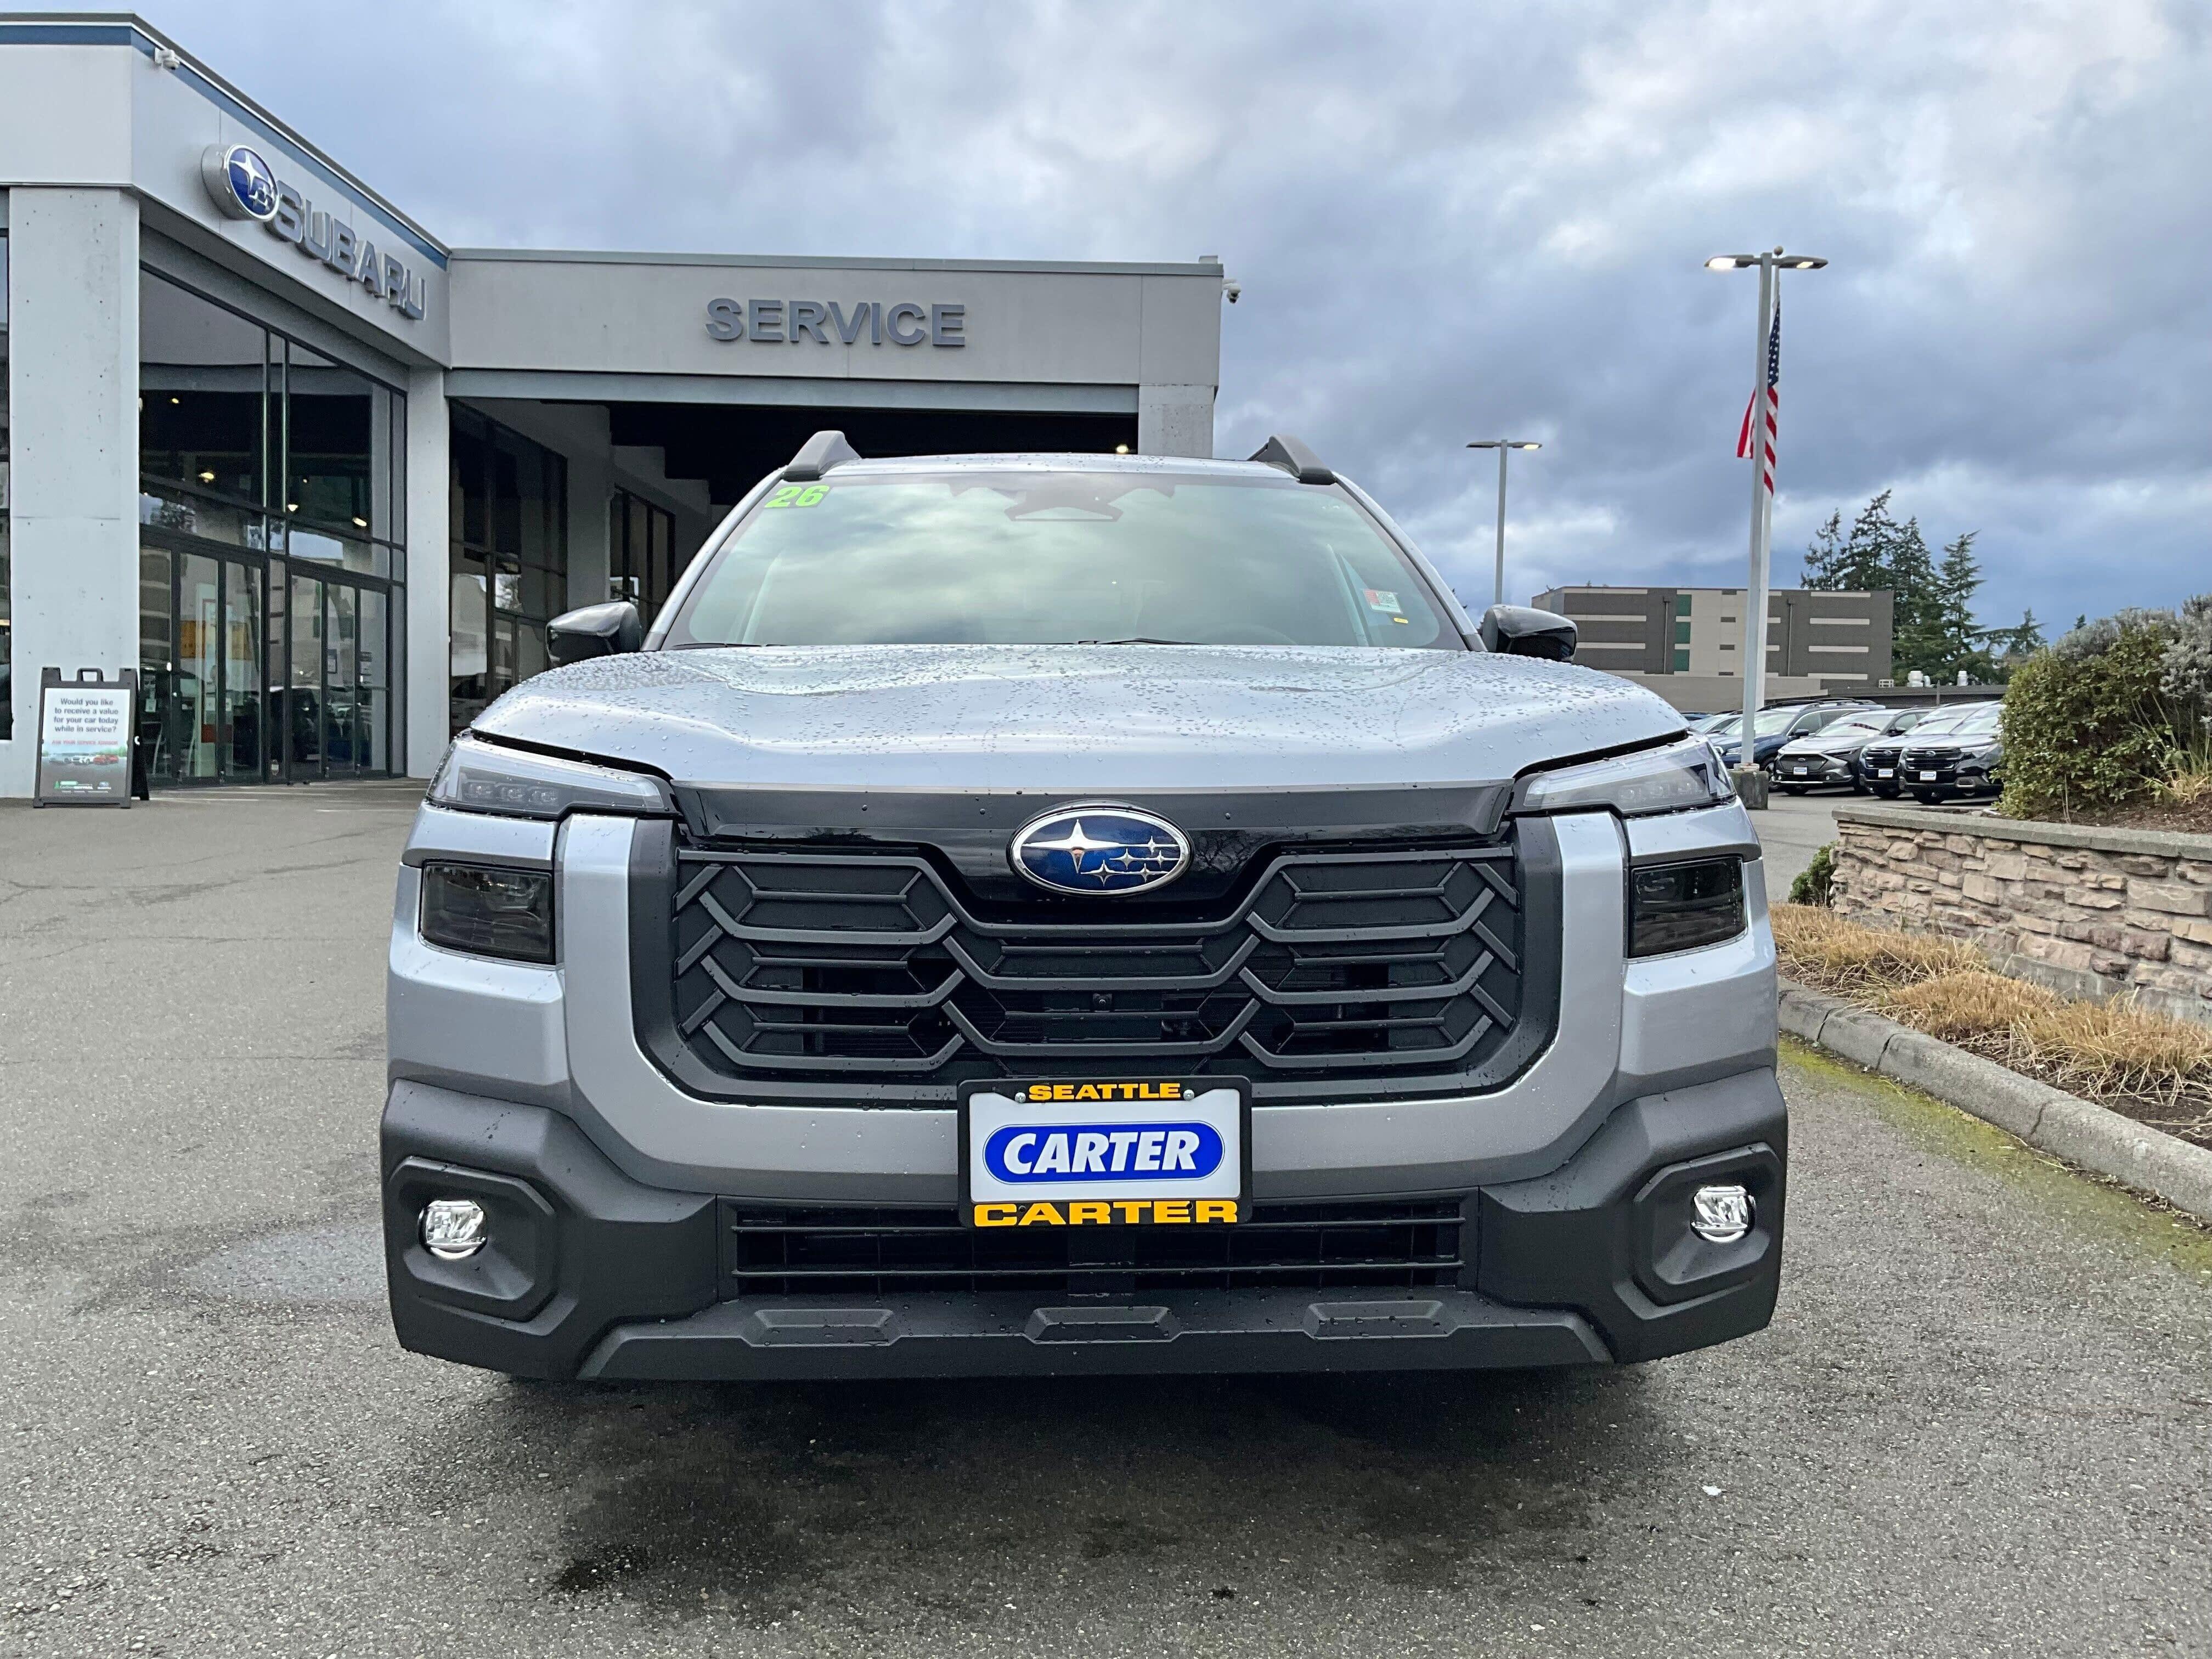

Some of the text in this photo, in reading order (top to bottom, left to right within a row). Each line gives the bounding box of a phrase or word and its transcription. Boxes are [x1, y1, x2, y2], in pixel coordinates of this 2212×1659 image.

[272, 180, 426, 321] SUBARU
[704, 298, 966, 346] SERVICE
[765, 485, 830, 508] 26
[1029, 1083, 1181, 1101] SEATTLE
[1003, 1130, 1200, 1175] CARTER
[974, 1200, 1238, 1227] CARTER
